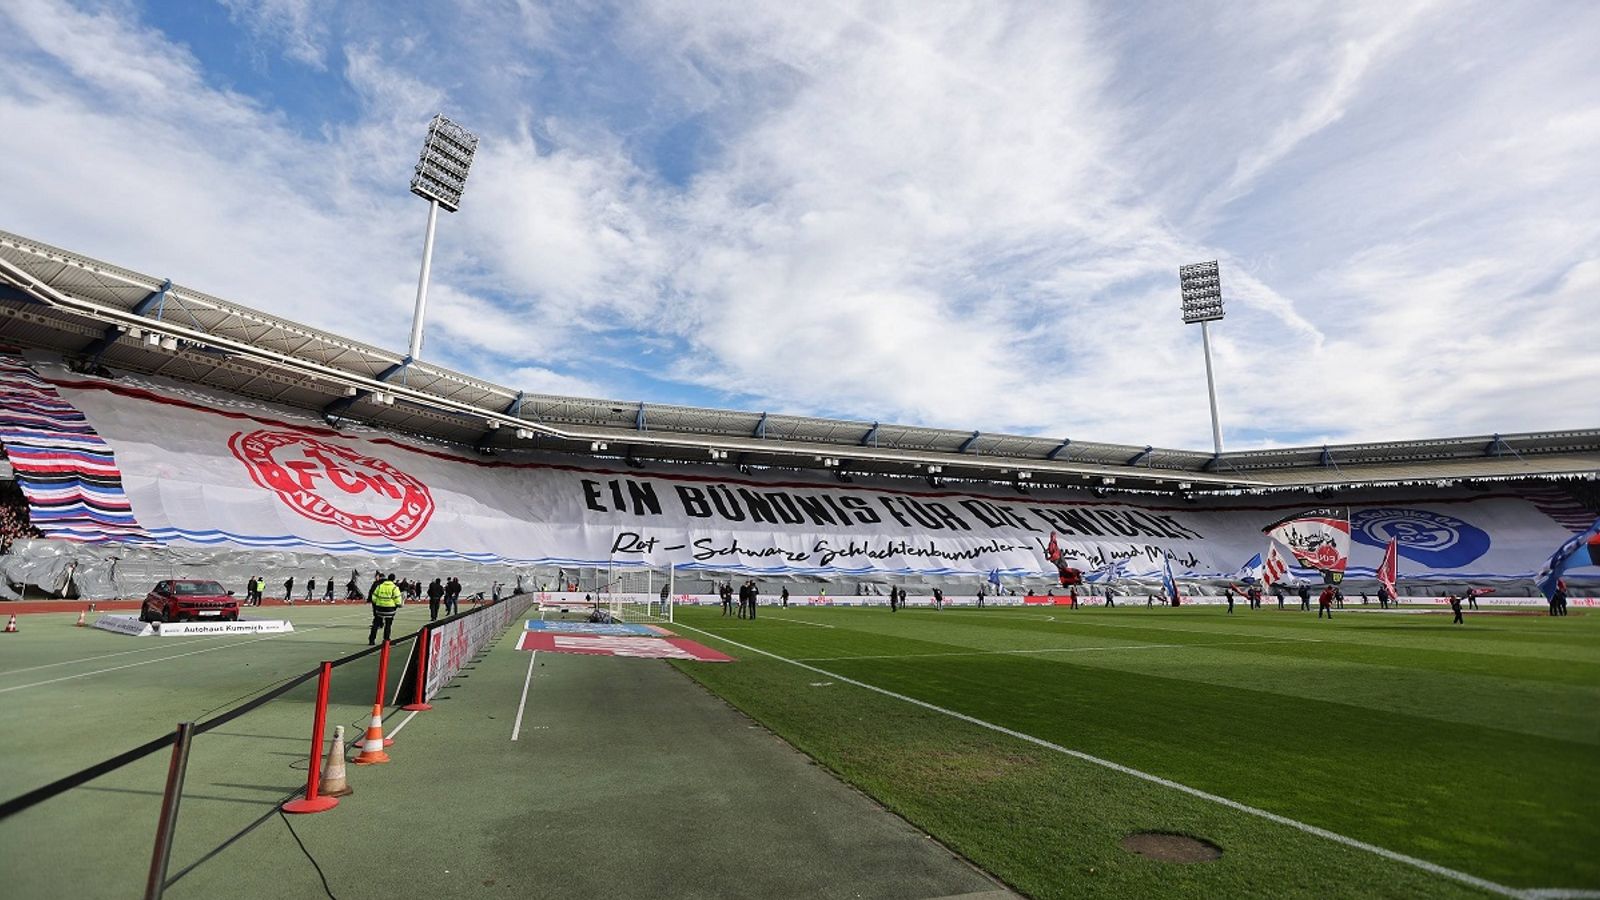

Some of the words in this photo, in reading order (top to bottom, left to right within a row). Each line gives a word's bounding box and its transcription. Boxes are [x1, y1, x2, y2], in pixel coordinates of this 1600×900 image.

[581, 479, 663, 516] EIN
[673, 484, 882, 526] BÜNDNIS
[877, 496, 972, 531] FÜR
[958, 499, 1044, 533] DIE
[1358, 509, 1432, 519] Schalke
[611, 532, 661, 554] Rot
[693, 538, 811, 561] Schwarze
[183, 625, 224, 633] Autohaus
